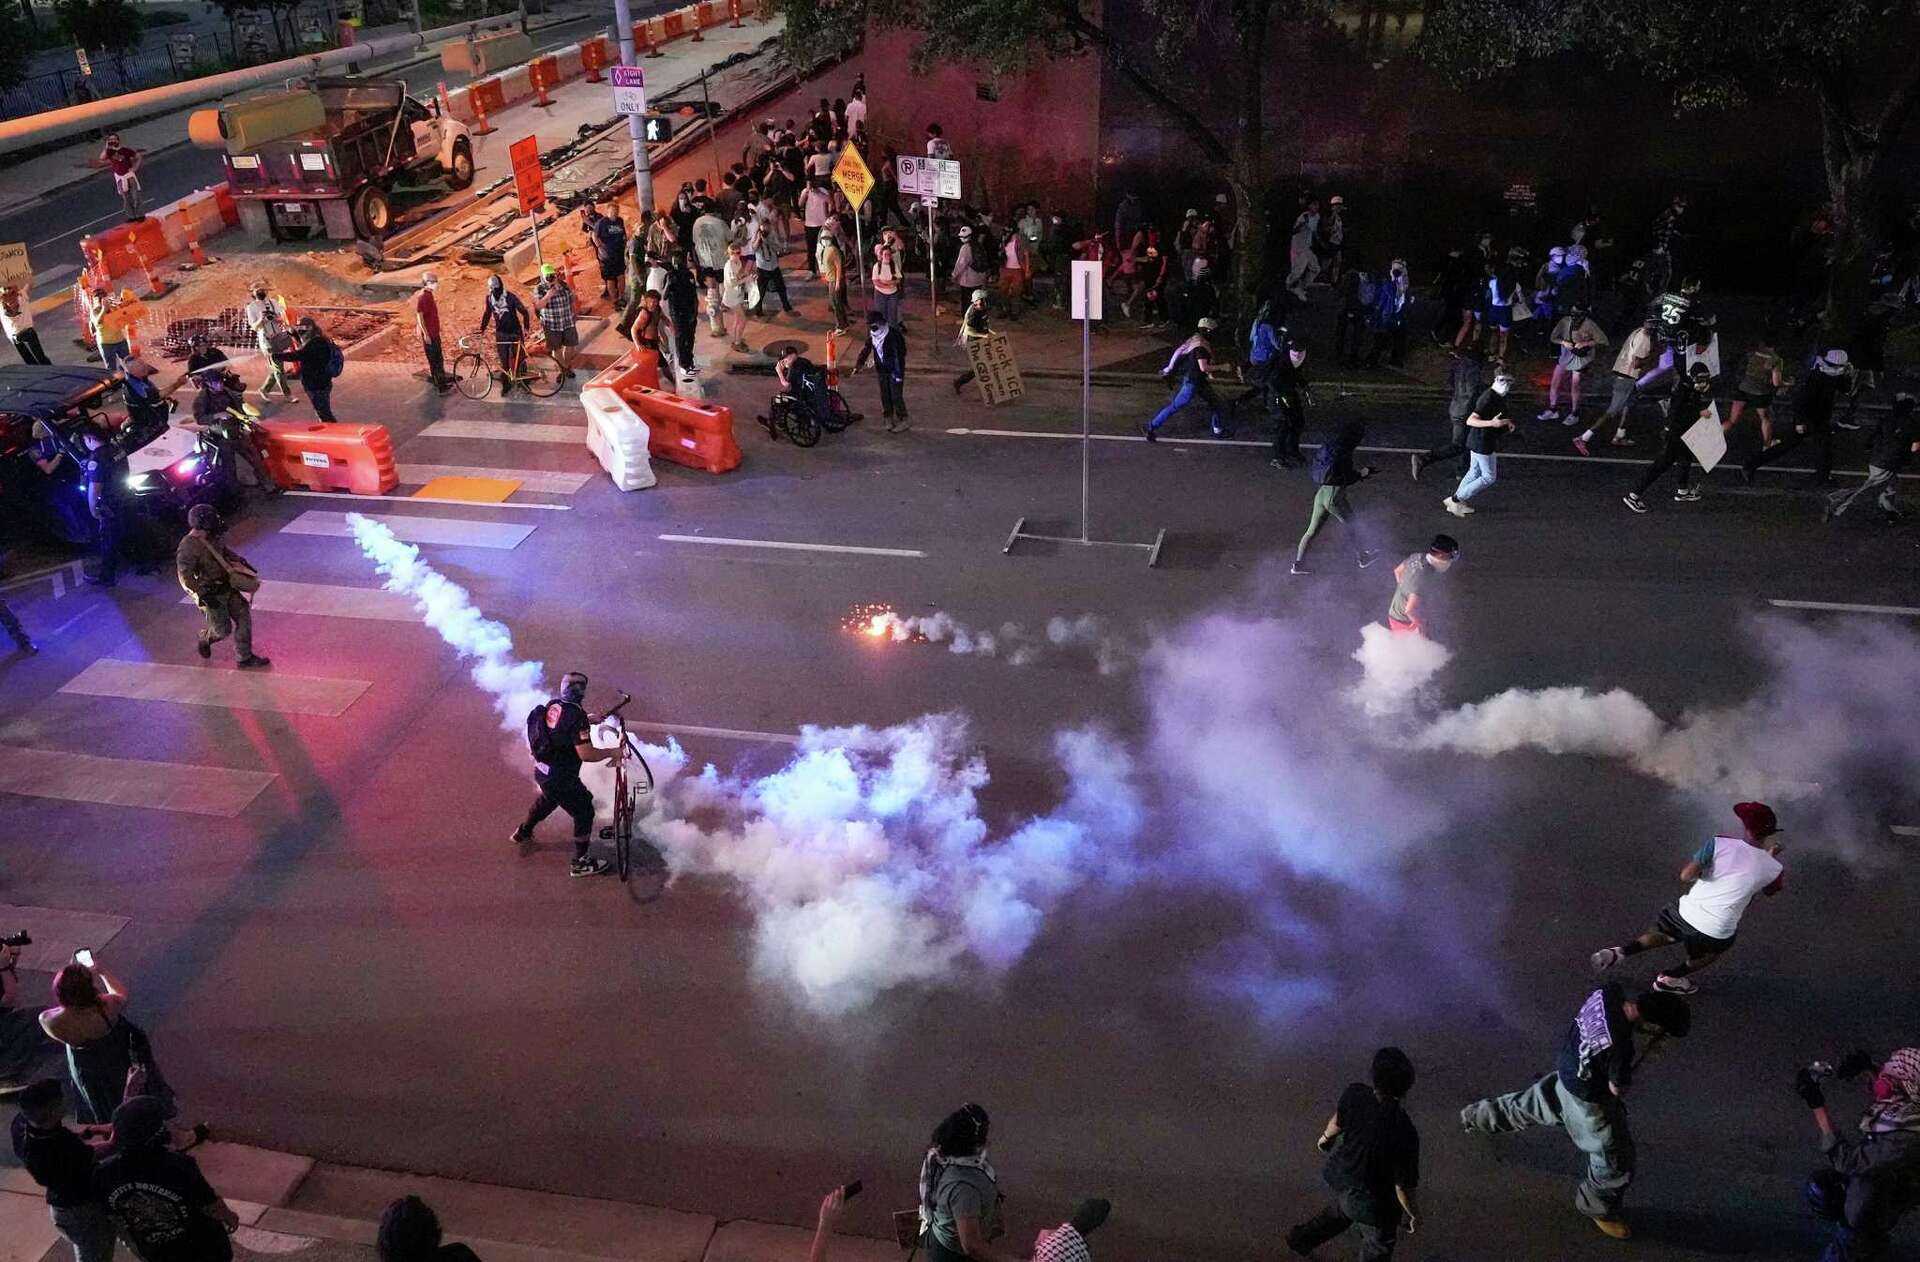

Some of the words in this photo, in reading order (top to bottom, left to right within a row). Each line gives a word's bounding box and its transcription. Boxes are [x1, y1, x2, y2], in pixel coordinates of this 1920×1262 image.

[620, 102, 641, 112] ONLY
[842, 170, 865, 184] MERGE
[844, 183, 865, 197] RIGHT
[1661, 304, 1686, 325] 25
[993, 335, 1014, 370] Fuck
[1006, 375, 1022, 398] ICE
